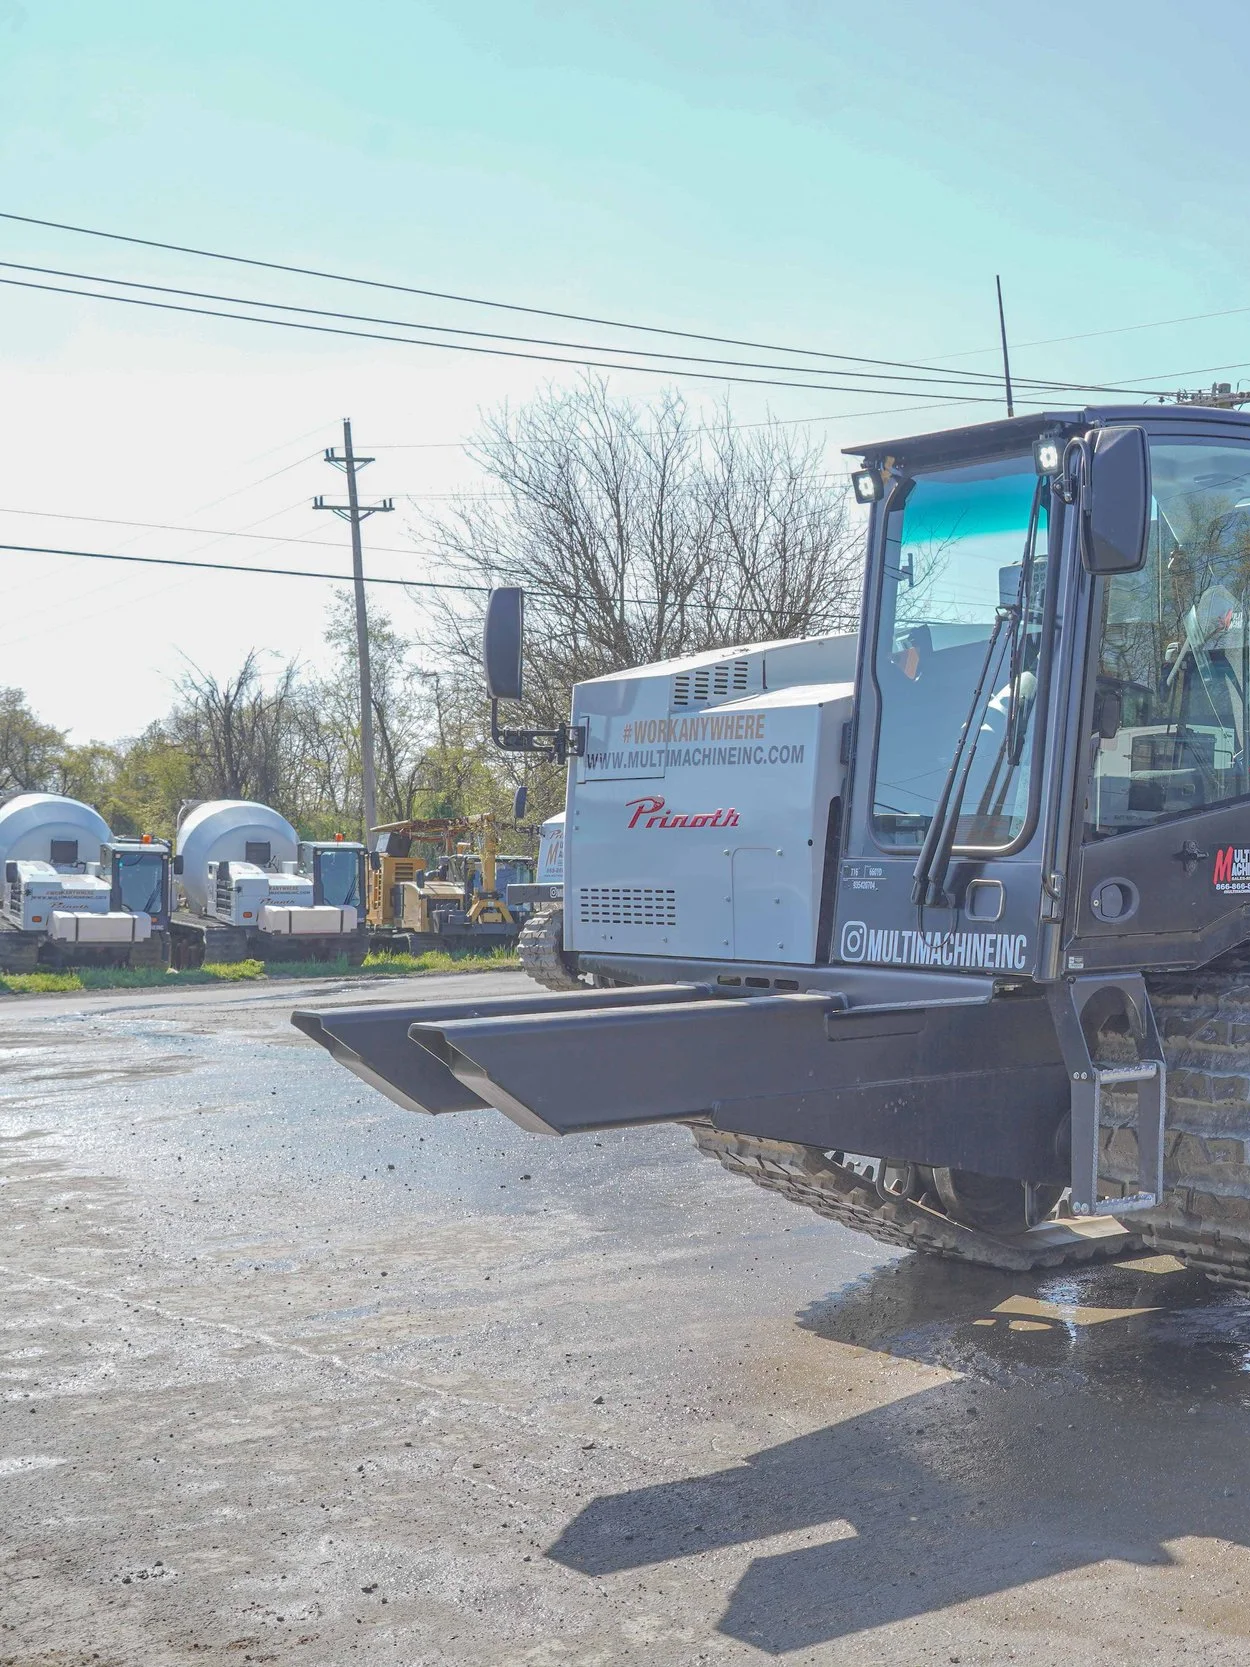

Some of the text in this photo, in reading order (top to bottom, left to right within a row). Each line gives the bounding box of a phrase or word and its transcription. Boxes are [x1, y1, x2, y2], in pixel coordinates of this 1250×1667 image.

[623, 714, 766, 744] #WORKANYWHERE
[587, 744, 805, 771] WWW.MULTIMACHINEINC.COM
[625, 795, 742, 829] Prinoth
[866, 928, 1027, 969] MULTIMACHINEINC
